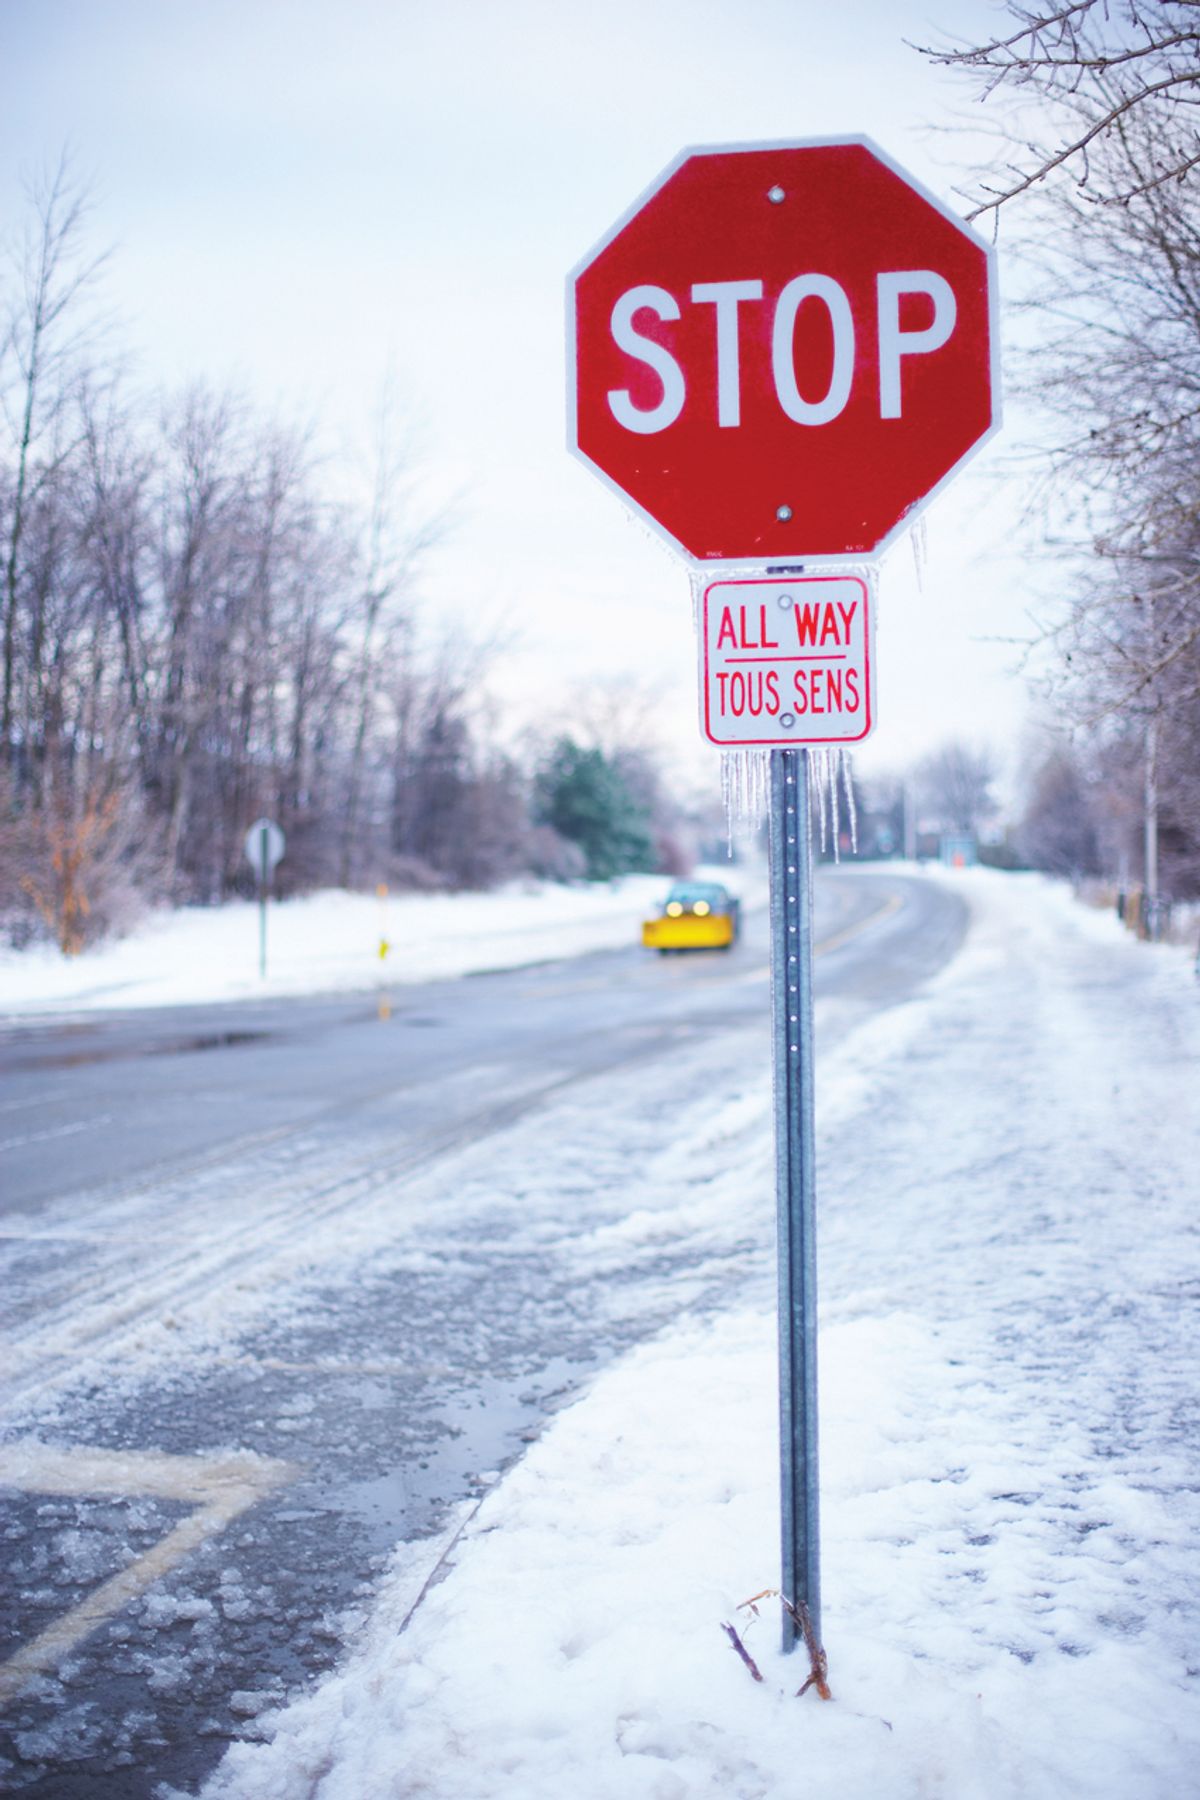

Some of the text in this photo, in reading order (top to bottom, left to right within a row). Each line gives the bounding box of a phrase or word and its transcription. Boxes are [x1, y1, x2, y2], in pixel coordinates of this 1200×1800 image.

[607, 269, 957, 435] STOP
[717, 601, 858, 650] ALL WAY
[716, 667, 860, 717] TOUS SENS
